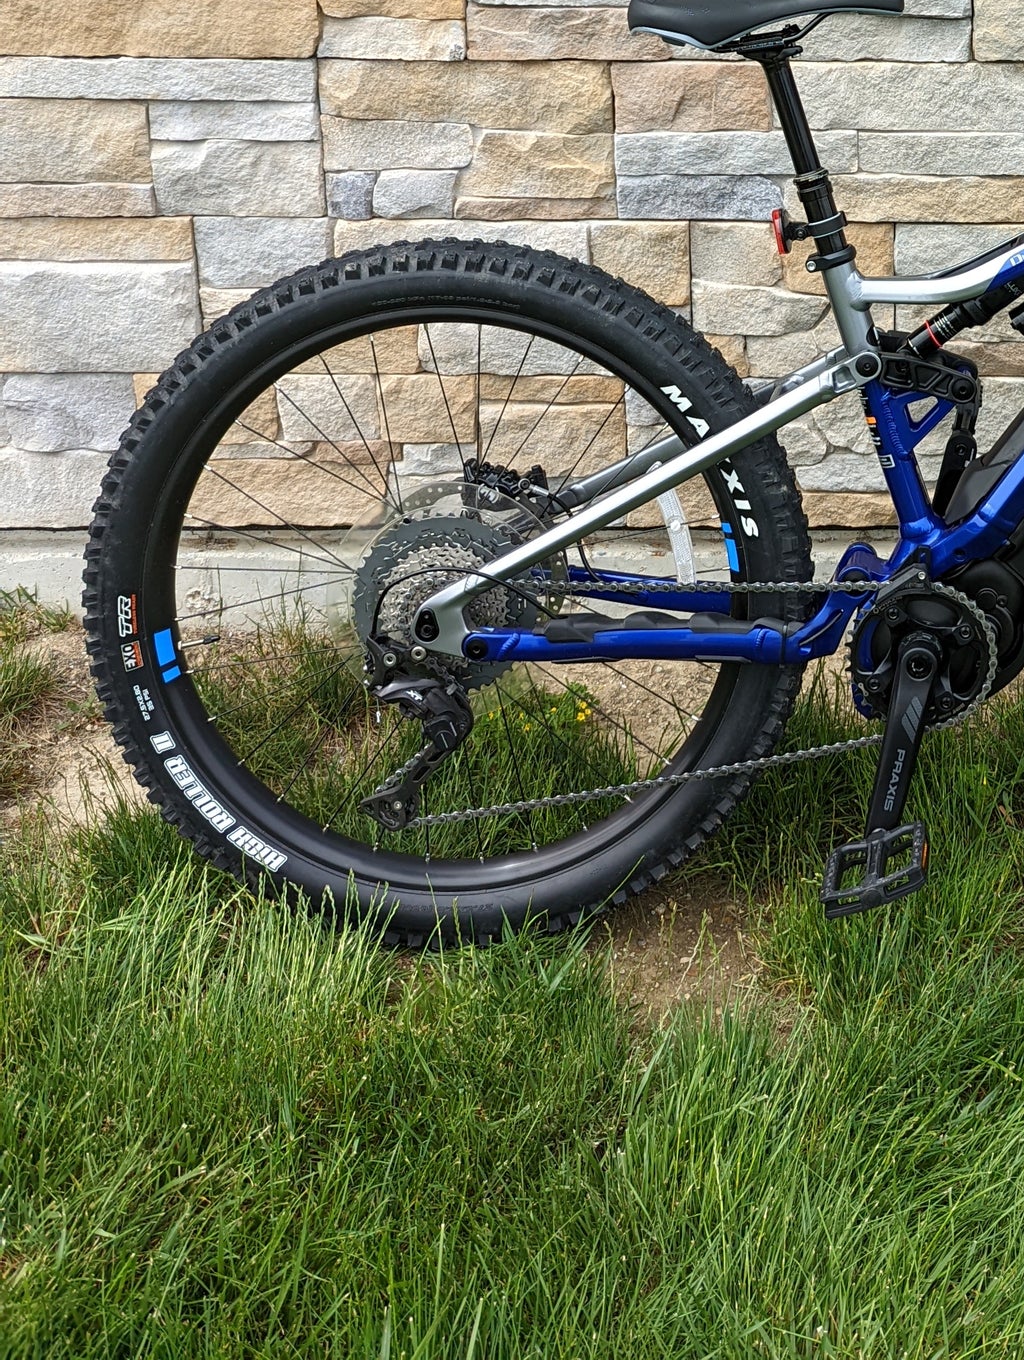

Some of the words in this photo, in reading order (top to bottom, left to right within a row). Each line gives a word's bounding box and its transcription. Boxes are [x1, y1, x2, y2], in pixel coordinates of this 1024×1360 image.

[660, 385, 759, 538] MAXIS
[117, 595, 133, 638] TR
[122, 643, 137, 669] EXO
[164, 755, 236, 833] ROLLER
[884, 748, 906, 812] PRAXIS
[227, 826, 288, 872] HIGH
